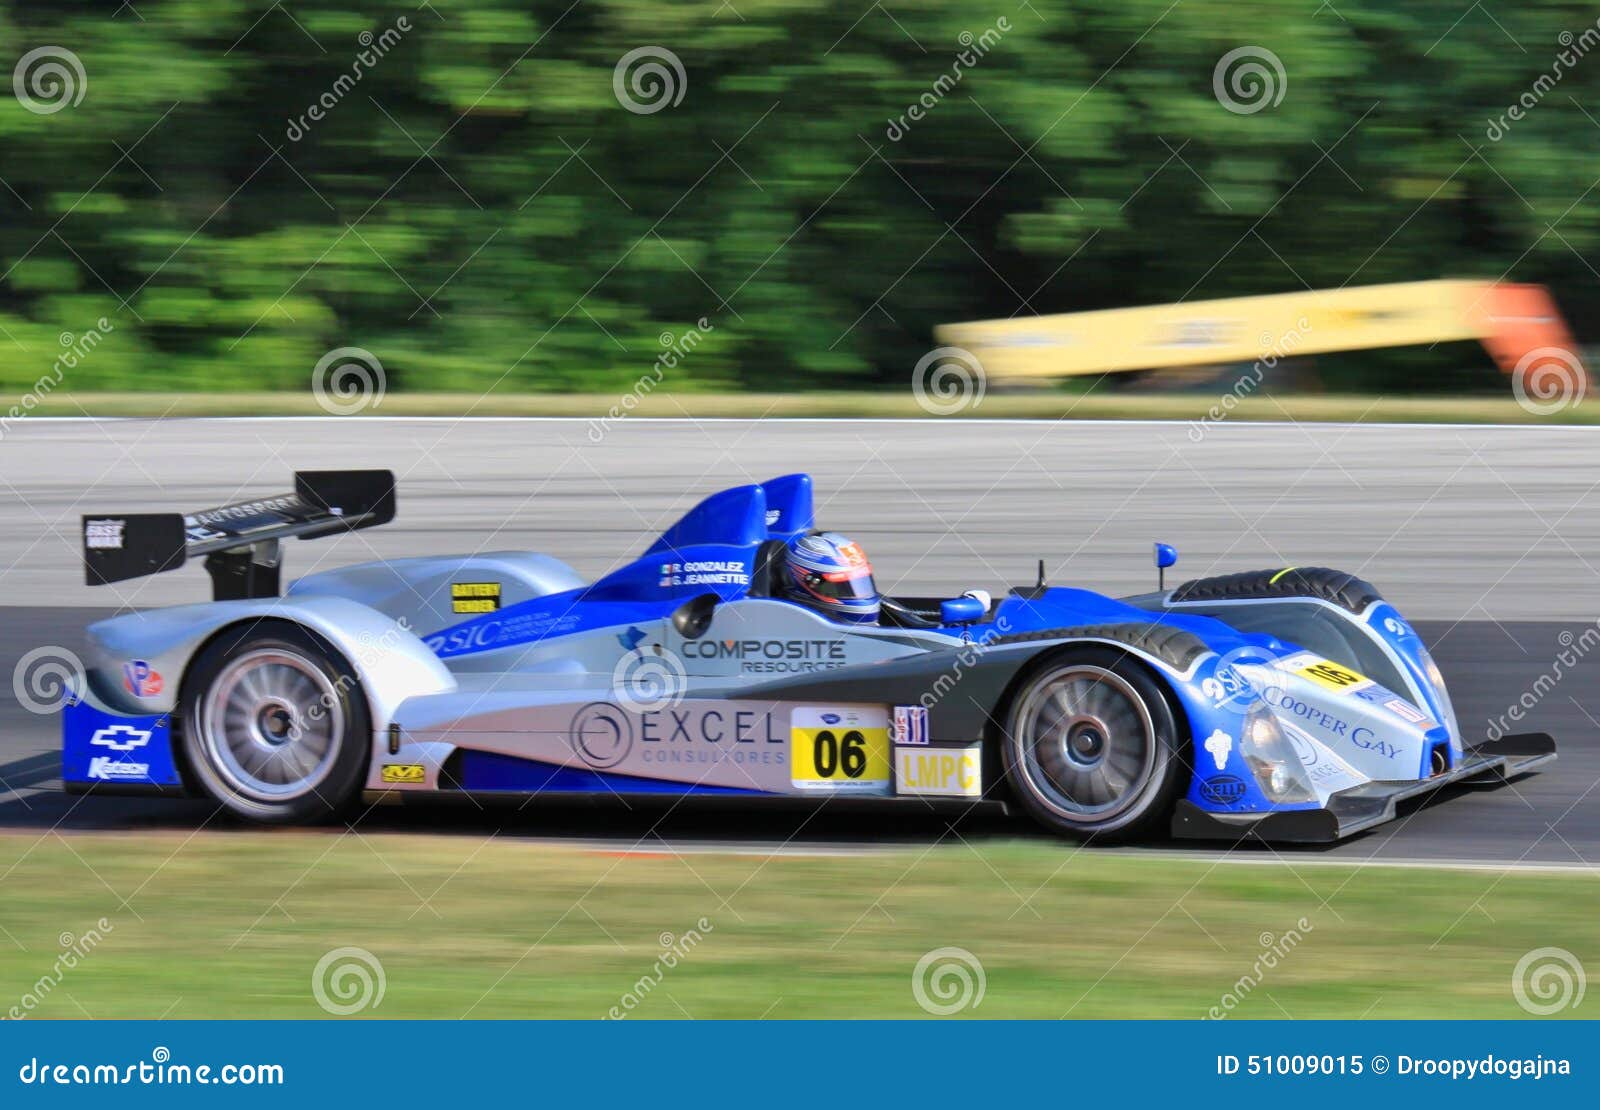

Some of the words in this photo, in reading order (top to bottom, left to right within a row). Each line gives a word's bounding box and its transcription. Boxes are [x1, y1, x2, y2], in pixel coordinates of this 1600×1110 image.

[684, 561, 745, 573] GONZALEZ
[684, 573, 749, 586] JEANNETTE
[681, 640, 846, 659] COMPOSITE
[641, 711, 784, 744] EXCEL
[1262, 686, 1347, 737] COOPER
[1351, 727, 1402, 760] GAY
[642, 750, 786, 764] CONSULTORES
[814, 730, 866, 778] 06
[904, 755, 973, 790] LMPC
